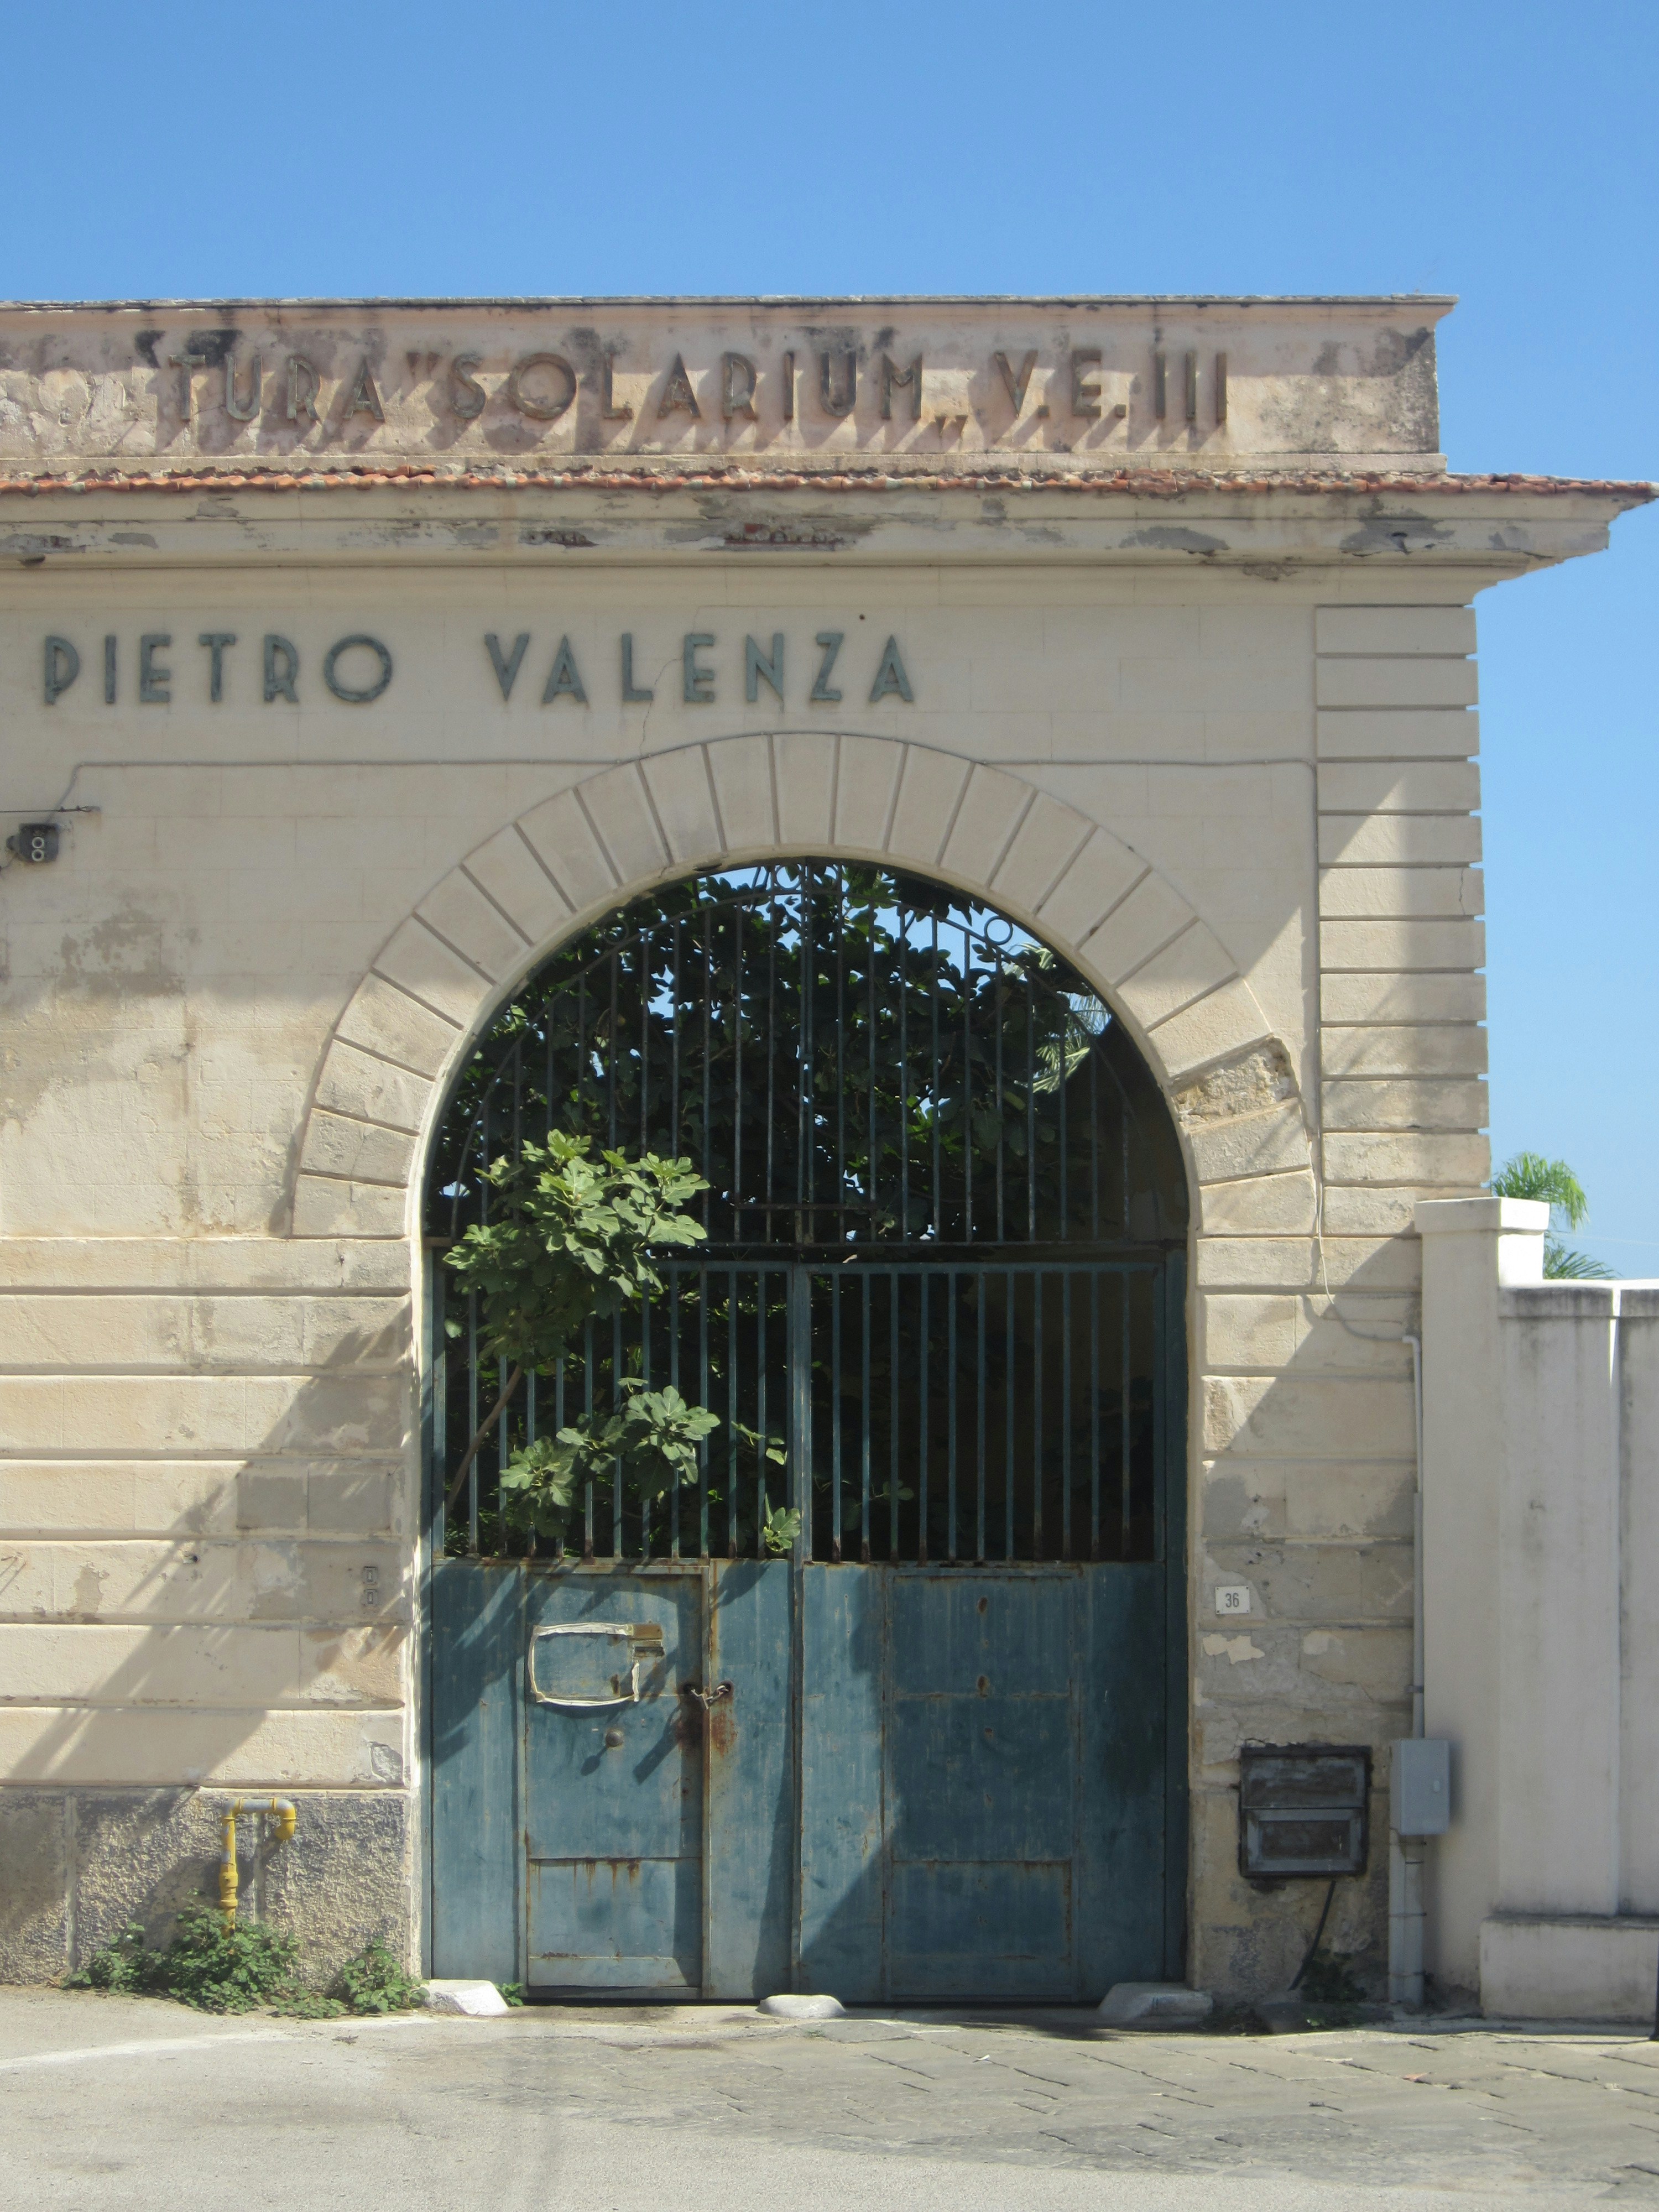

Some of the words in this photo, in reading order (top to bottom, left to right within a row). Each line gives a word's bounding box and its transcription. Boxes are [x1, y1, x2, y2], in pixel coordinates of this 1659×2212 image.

[168, 353, 386, 422] TURA
[44, 633, 394, 705] PIETRO
[483, 632, 915, 705] VALENZA
[1225, 1592, 1240, 1608] 36
